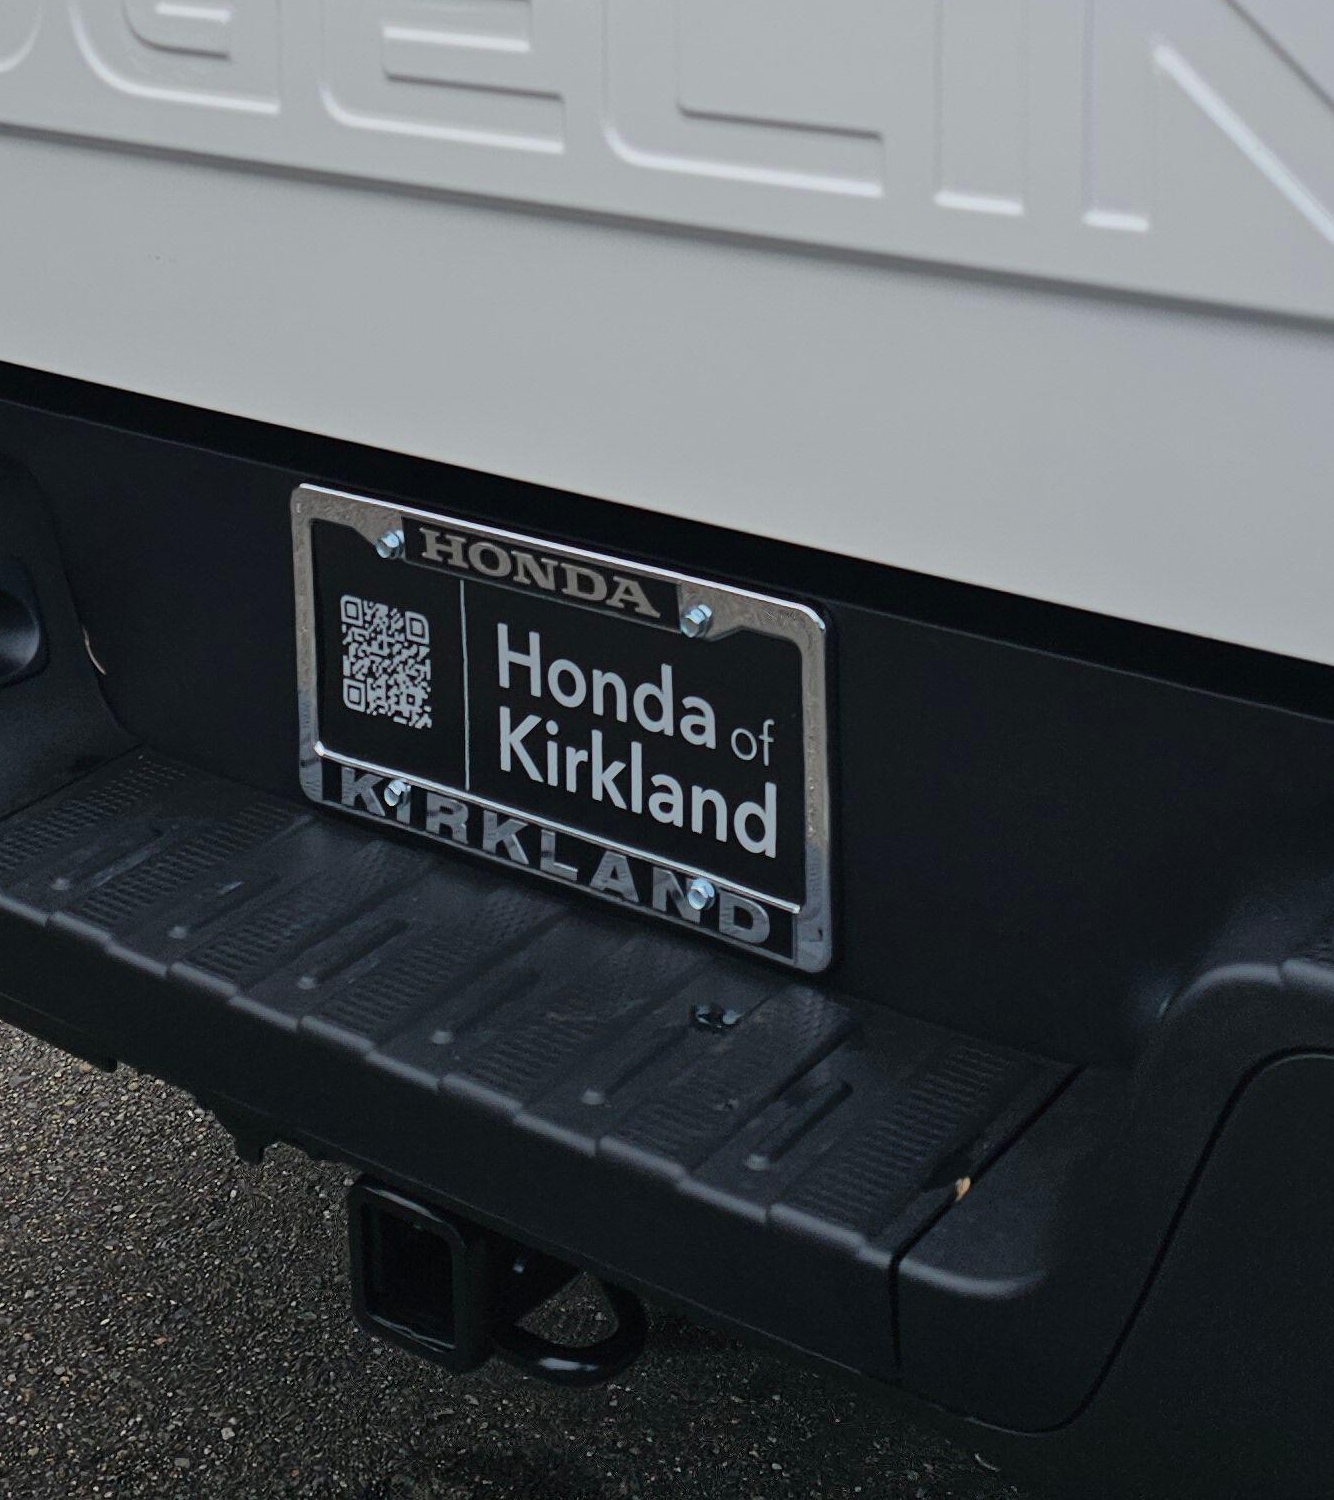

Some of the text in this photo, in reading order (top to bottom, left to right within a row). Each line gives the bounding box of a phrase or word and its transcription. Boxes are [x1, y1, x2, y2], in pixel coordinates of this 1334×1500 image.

[419, 526, 661, 619] HONDA
[496, 622, 775, 766] Honda of
[499, 706, 777, 859] Kirkland
